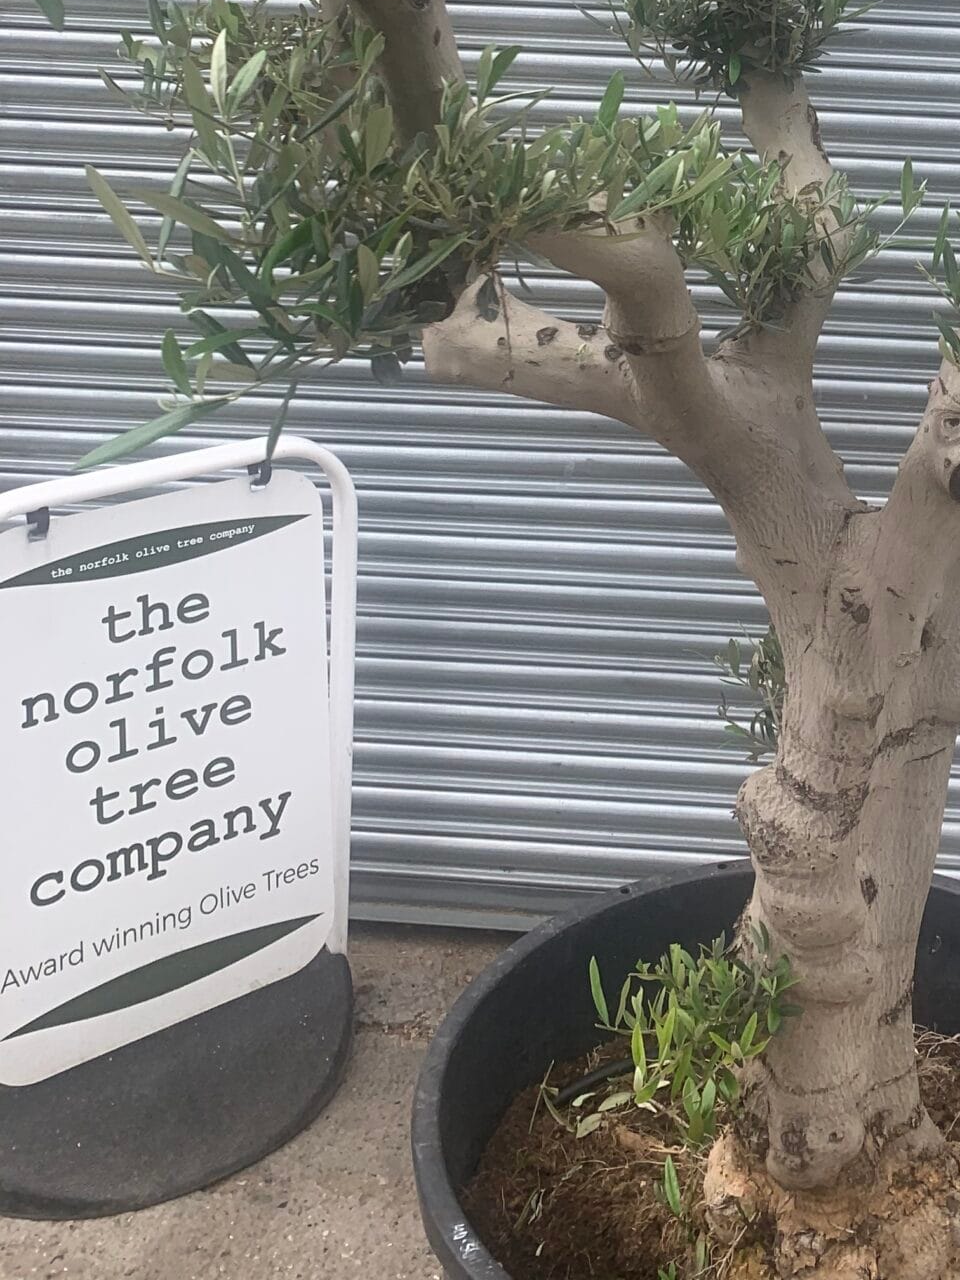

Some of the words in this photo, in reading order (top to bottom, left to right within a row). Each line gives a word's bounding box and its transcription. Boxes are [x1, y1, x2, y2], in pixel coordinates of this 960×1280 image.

[51, 566, 73, 579] the
[79, 552, 129, 572] norfolk
[136, 542, 170, 559] olive
[177, 534, 203, 548] tree
[209, 523, 256, 541] company
[101, 592, 210, 644] the
[21, 621, 287, 729] norfolk
[65, 694, 252, 773] olive
[89, 755, 236, 825] tree
[30, 791, 292, 907] company
[0, 941, 85, 994] Award
[92, 906, 192, 957] winning
[199, 883, 257, 915] Olive
[262, 858, 320, 893] Trees
